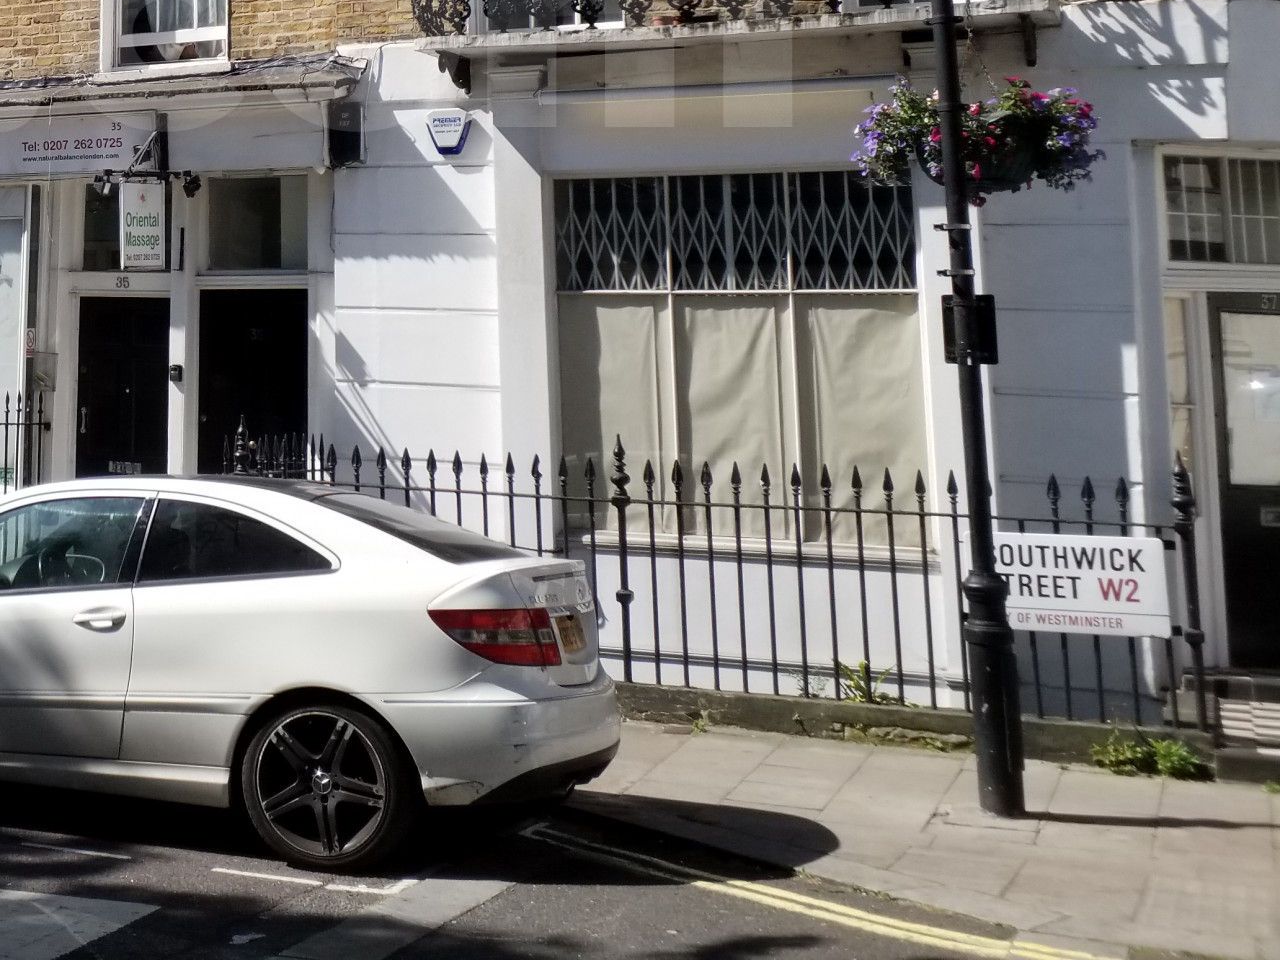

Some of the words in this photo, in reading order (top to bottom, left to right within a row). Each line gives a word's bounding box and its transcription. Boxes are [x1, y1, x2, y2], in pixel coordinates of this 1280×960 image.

[111, 122, 122, 131] 35
[22, 141, 40, 152] Tel:
[43, 140, 69, 151] 0207
[74, 139, 94, 150] 262
[96, 138, 123, 148] 0725
[22, 153, 120, 162] www.naturalbalancelondon.com
[125, 212, 160, 227] Oriental
[125, 231, 160, 249] Massage
[115, 276, 130, 289] 35
[1261, 294, 1277, 310] 37
[994, 544, 1146, 572] OUTHWICK
[997, 573, 1081, 599] TREET
[1097, 577, 1141, 603] W2
[1017, 612, 1031, 623] OF
[1036, 614, 1123, 629] WESTMINSTER
